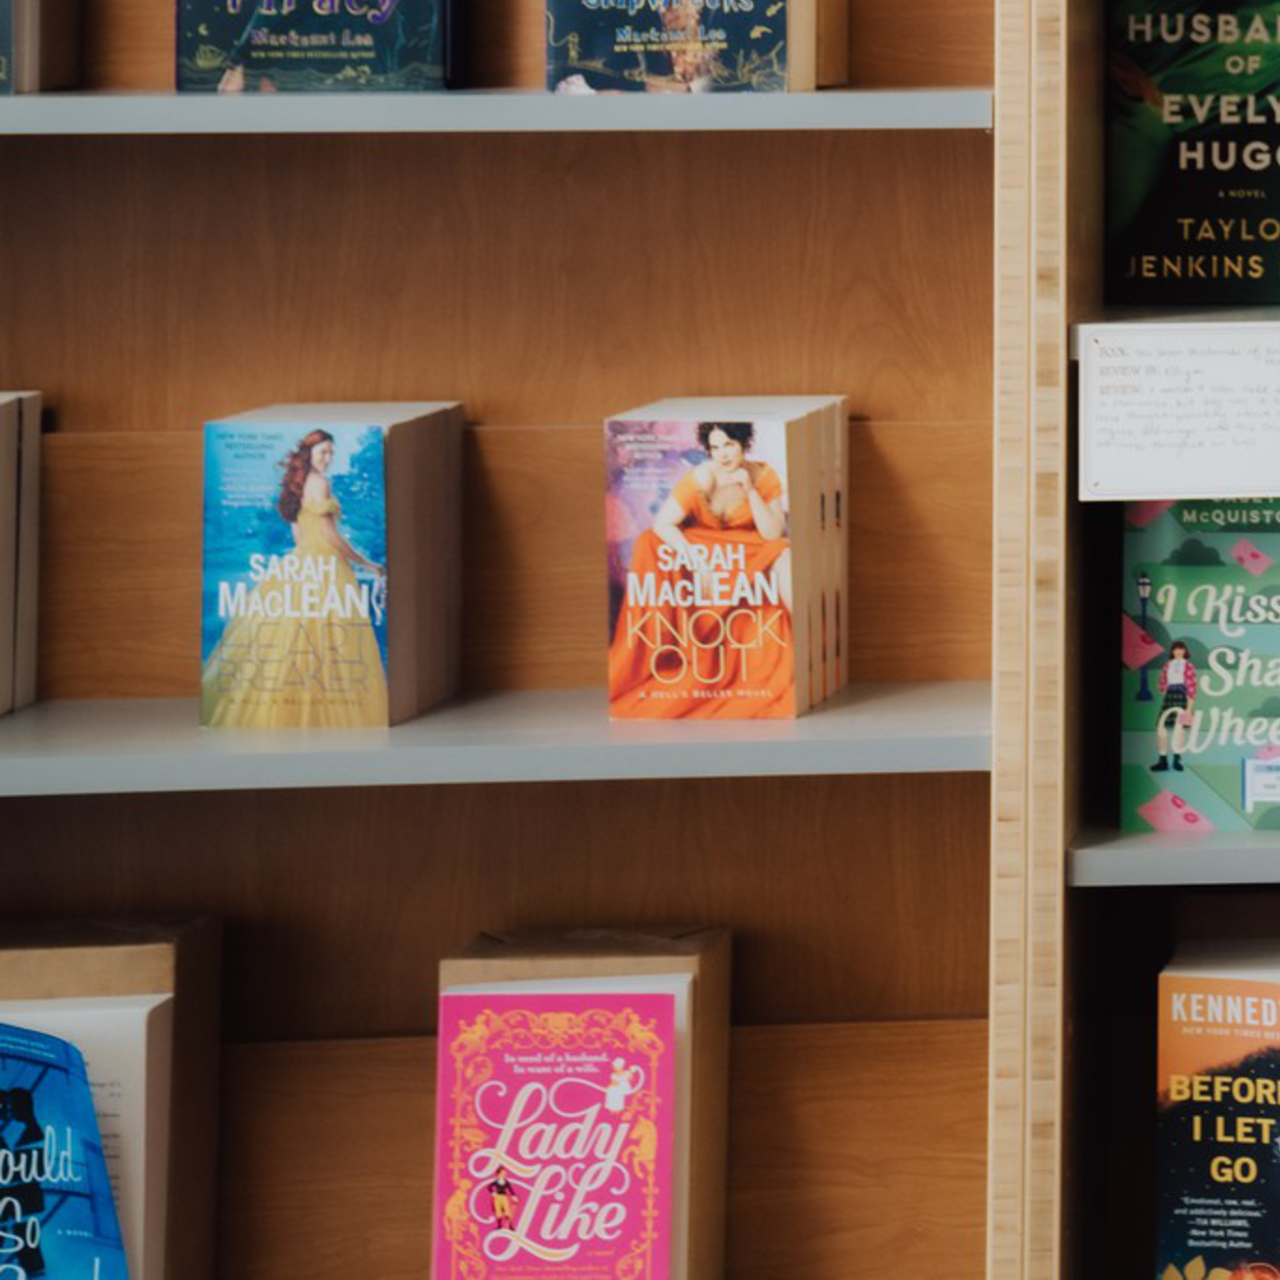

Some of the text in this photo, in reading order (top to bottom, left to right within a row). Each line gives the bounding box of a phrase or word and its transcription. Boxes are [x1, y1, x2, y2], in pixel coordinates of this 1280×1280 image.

[1225, 53, 1263, 76] OF
[1126, 254, 1265, 279] JENKINS
[249, 553, 338, 583] SARAH
[656, 543, 746, 571] SARAH
[1156, 583, 1177, 623] I
[626, 608, 788, 650] KNOCK
[650, 643, 749, 685] OUT
[1192, 1116, 1276, 1144] I LET
[1210, 1156, 1258, 1184] GO
